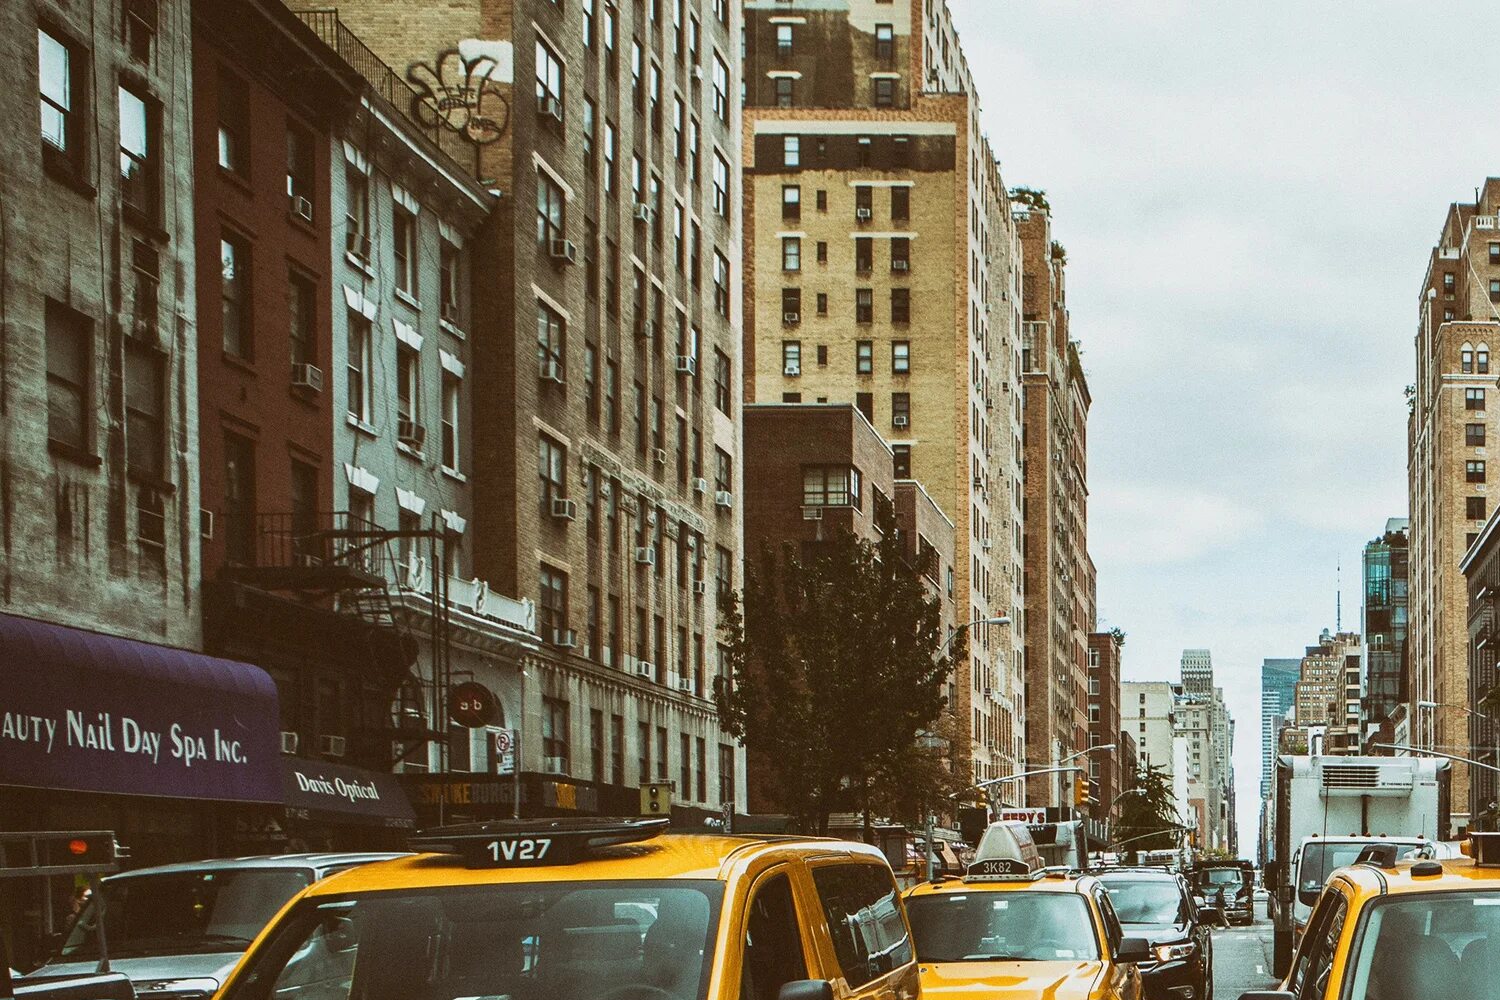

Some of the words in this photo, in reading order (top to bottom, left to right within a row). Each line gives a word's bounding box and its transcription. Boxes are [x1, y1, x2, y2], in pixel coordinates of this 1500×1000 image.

[295, 771, 336, 796] Davis
[335, 777, 381, 803] Optical
[487, 838, 552, 861] 1V27
[983, 861, 1012, 874] 3K82
